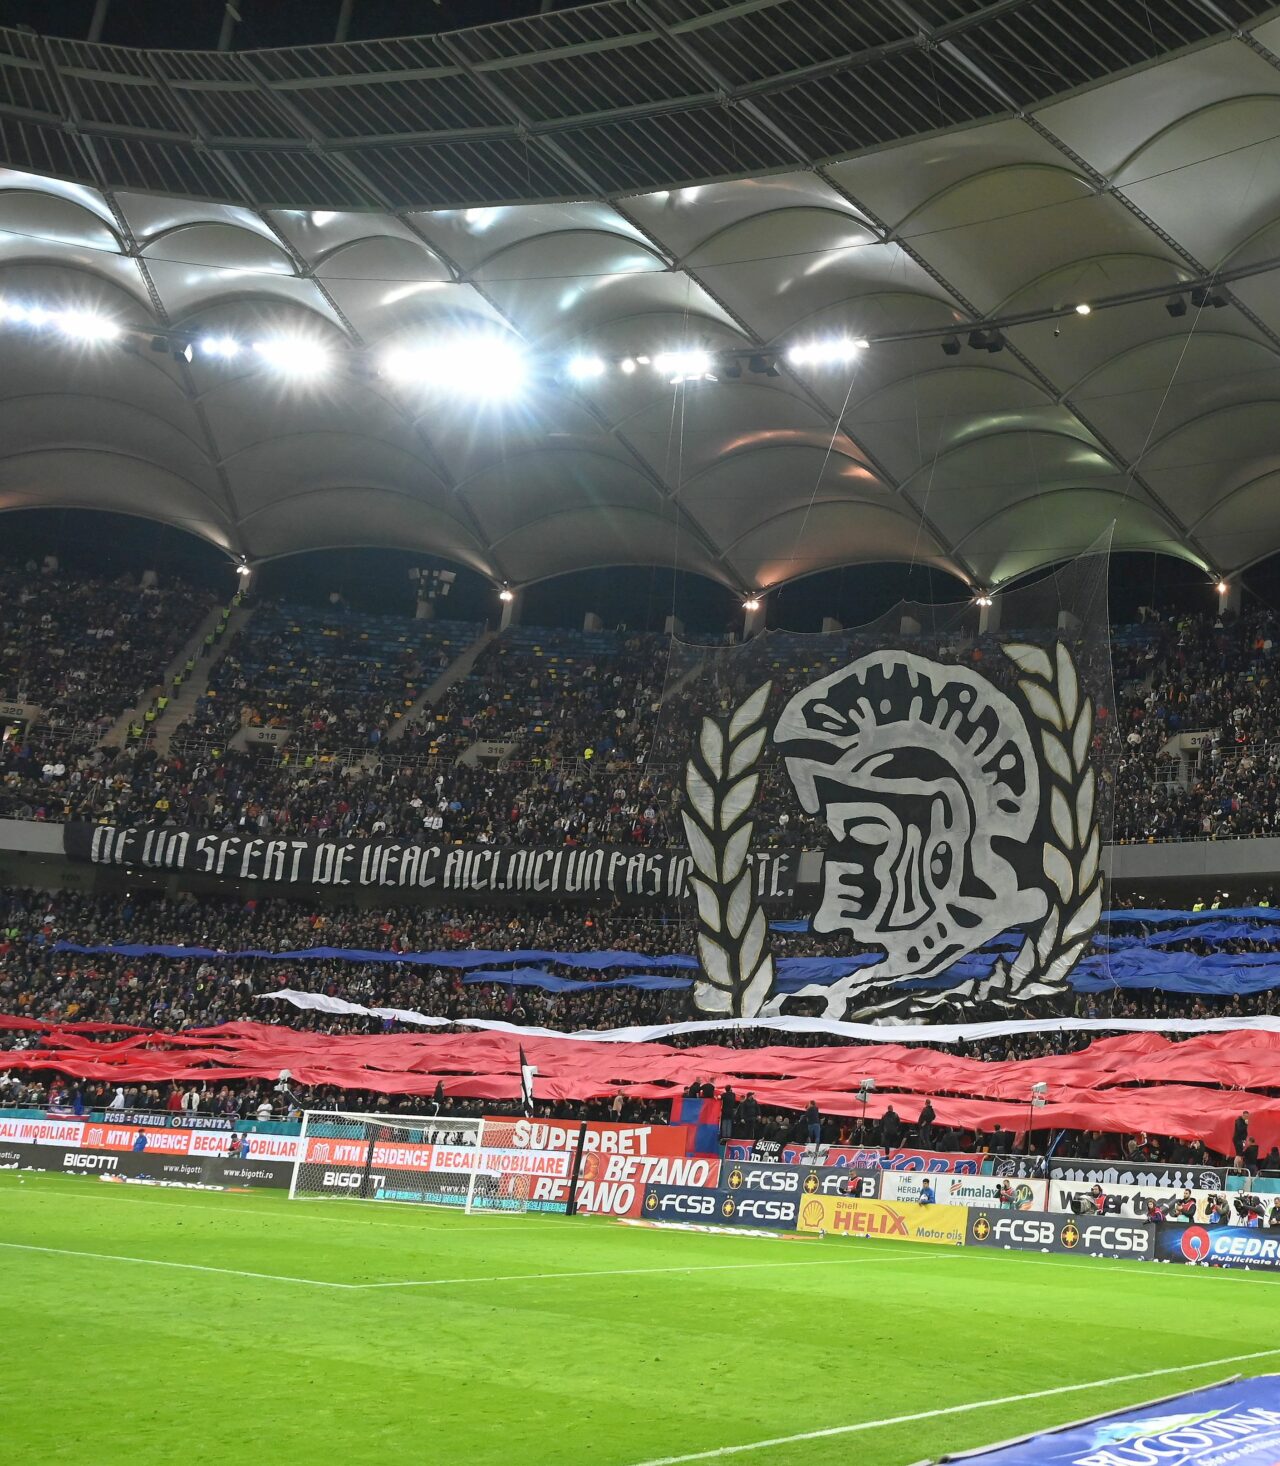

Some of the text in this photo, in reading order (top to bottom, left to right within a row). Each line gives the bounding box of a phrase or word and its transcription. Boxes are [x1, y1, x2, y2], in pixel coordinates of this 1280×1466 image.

[2, 706, 24, 716] 320
[257, 732, 277, 741] 318
[487, 747, 505, 755] 316
[142, 829, 190, 867] UN
[196, 834, 308, 883] SFERT
[312, 842, 356, 885] DE
[360, 844, 441, 888] VEAC
[565, 848, 605, 892] UN
[608, 851, 664, 896] PAS
[104, 1112, 124, 1123] FCSB
[132, 1114, 166, 1127] STEAUA
[20, 1122, 80, 1141] IMOBILIARE
[107, 1130, 129, 1146] MTM
[512, 1119, 651, 1155] SUPERBET
[755, 1140, 780, 1152] SKINS
[63, 1153, 119, 1170] BIGOTTI
[333, 1145, 361, 1162] MTM
[486, 1153, 565, 1175] IMOBILIARE
[603, 1154, 710, 1187] BETANO
[223, 1168, 274, 1180] www.bigotti.ro
[744, 1170, 799, 1192] FCSB
[898, 1175, 912, 1183] THE
[822, 1175, 875, 1197] FCB
[660, 1193, 715, 1215] FCSB
[736, 1200, 795, 1221] FCSB
[836, 1201, 858, 1210] Shell
[833, 1208, 909, 1236] HELIX
[992, 1218, 1055, 1244] FCSB
[916, 1226, 963, 1241] Motor oils
[1082, 1226, 1149, 1252] FCSB
[1211, 1254, 1272, 1266] Publicitate
